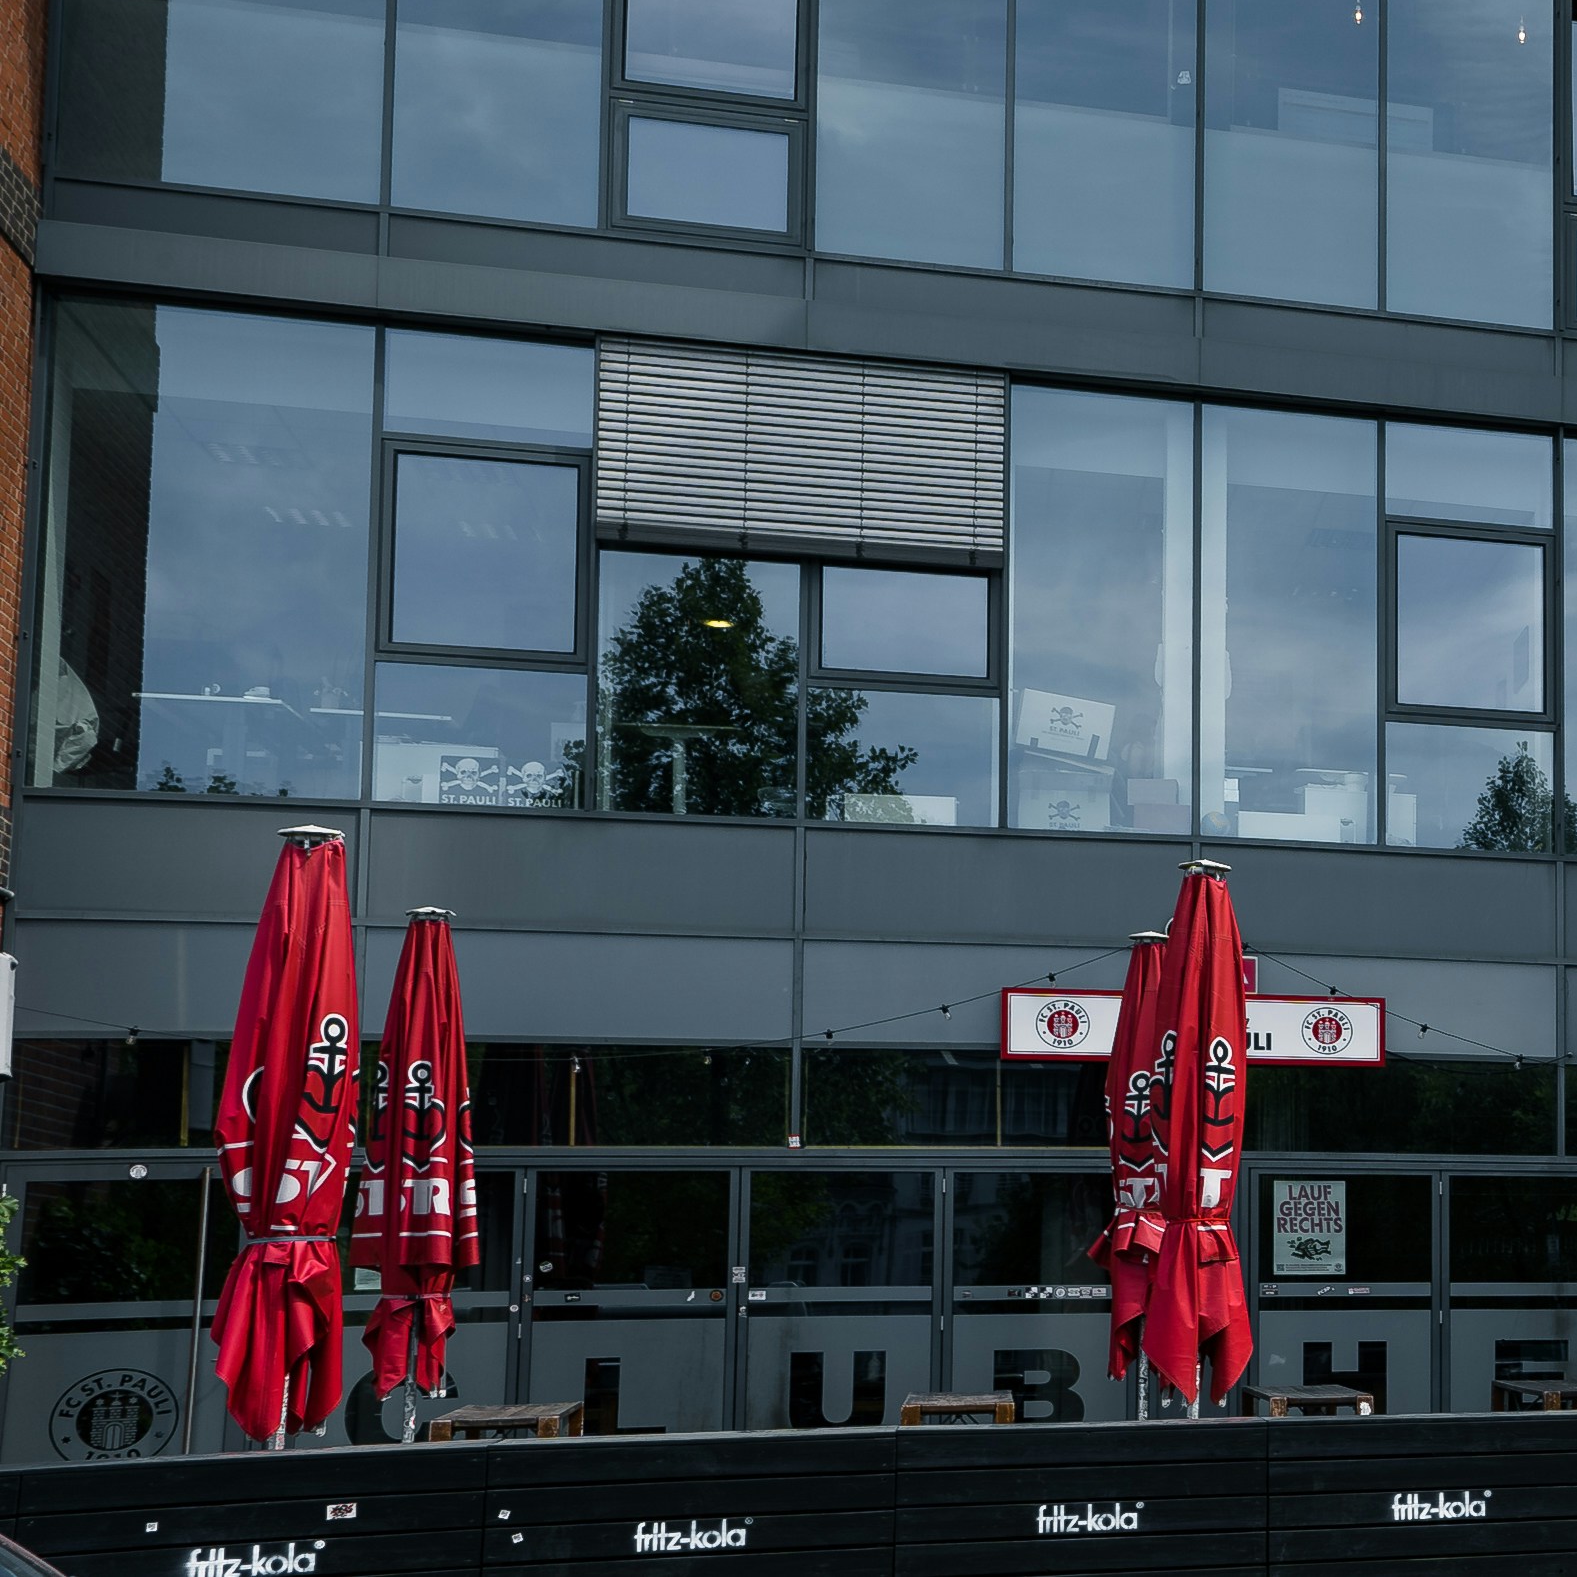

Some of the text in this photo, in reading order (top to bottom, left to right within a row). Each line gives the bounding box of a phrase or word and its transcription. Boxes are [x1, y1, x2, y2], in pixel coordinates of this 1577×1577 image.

[441, 793, 497, 806] ST. PAULI
[526, 798, 562, 808] PAULI
[1063, 1002, 1088, 1023] PAULI
[1288, 1185, 1332, 1201] LAUF
[1279, 1201, 1340, 1217] GEGEN
[1277, 1217, 1343, 1234] RECHTS
[59, 1374, 172, 1418] FC ST. PAULI
